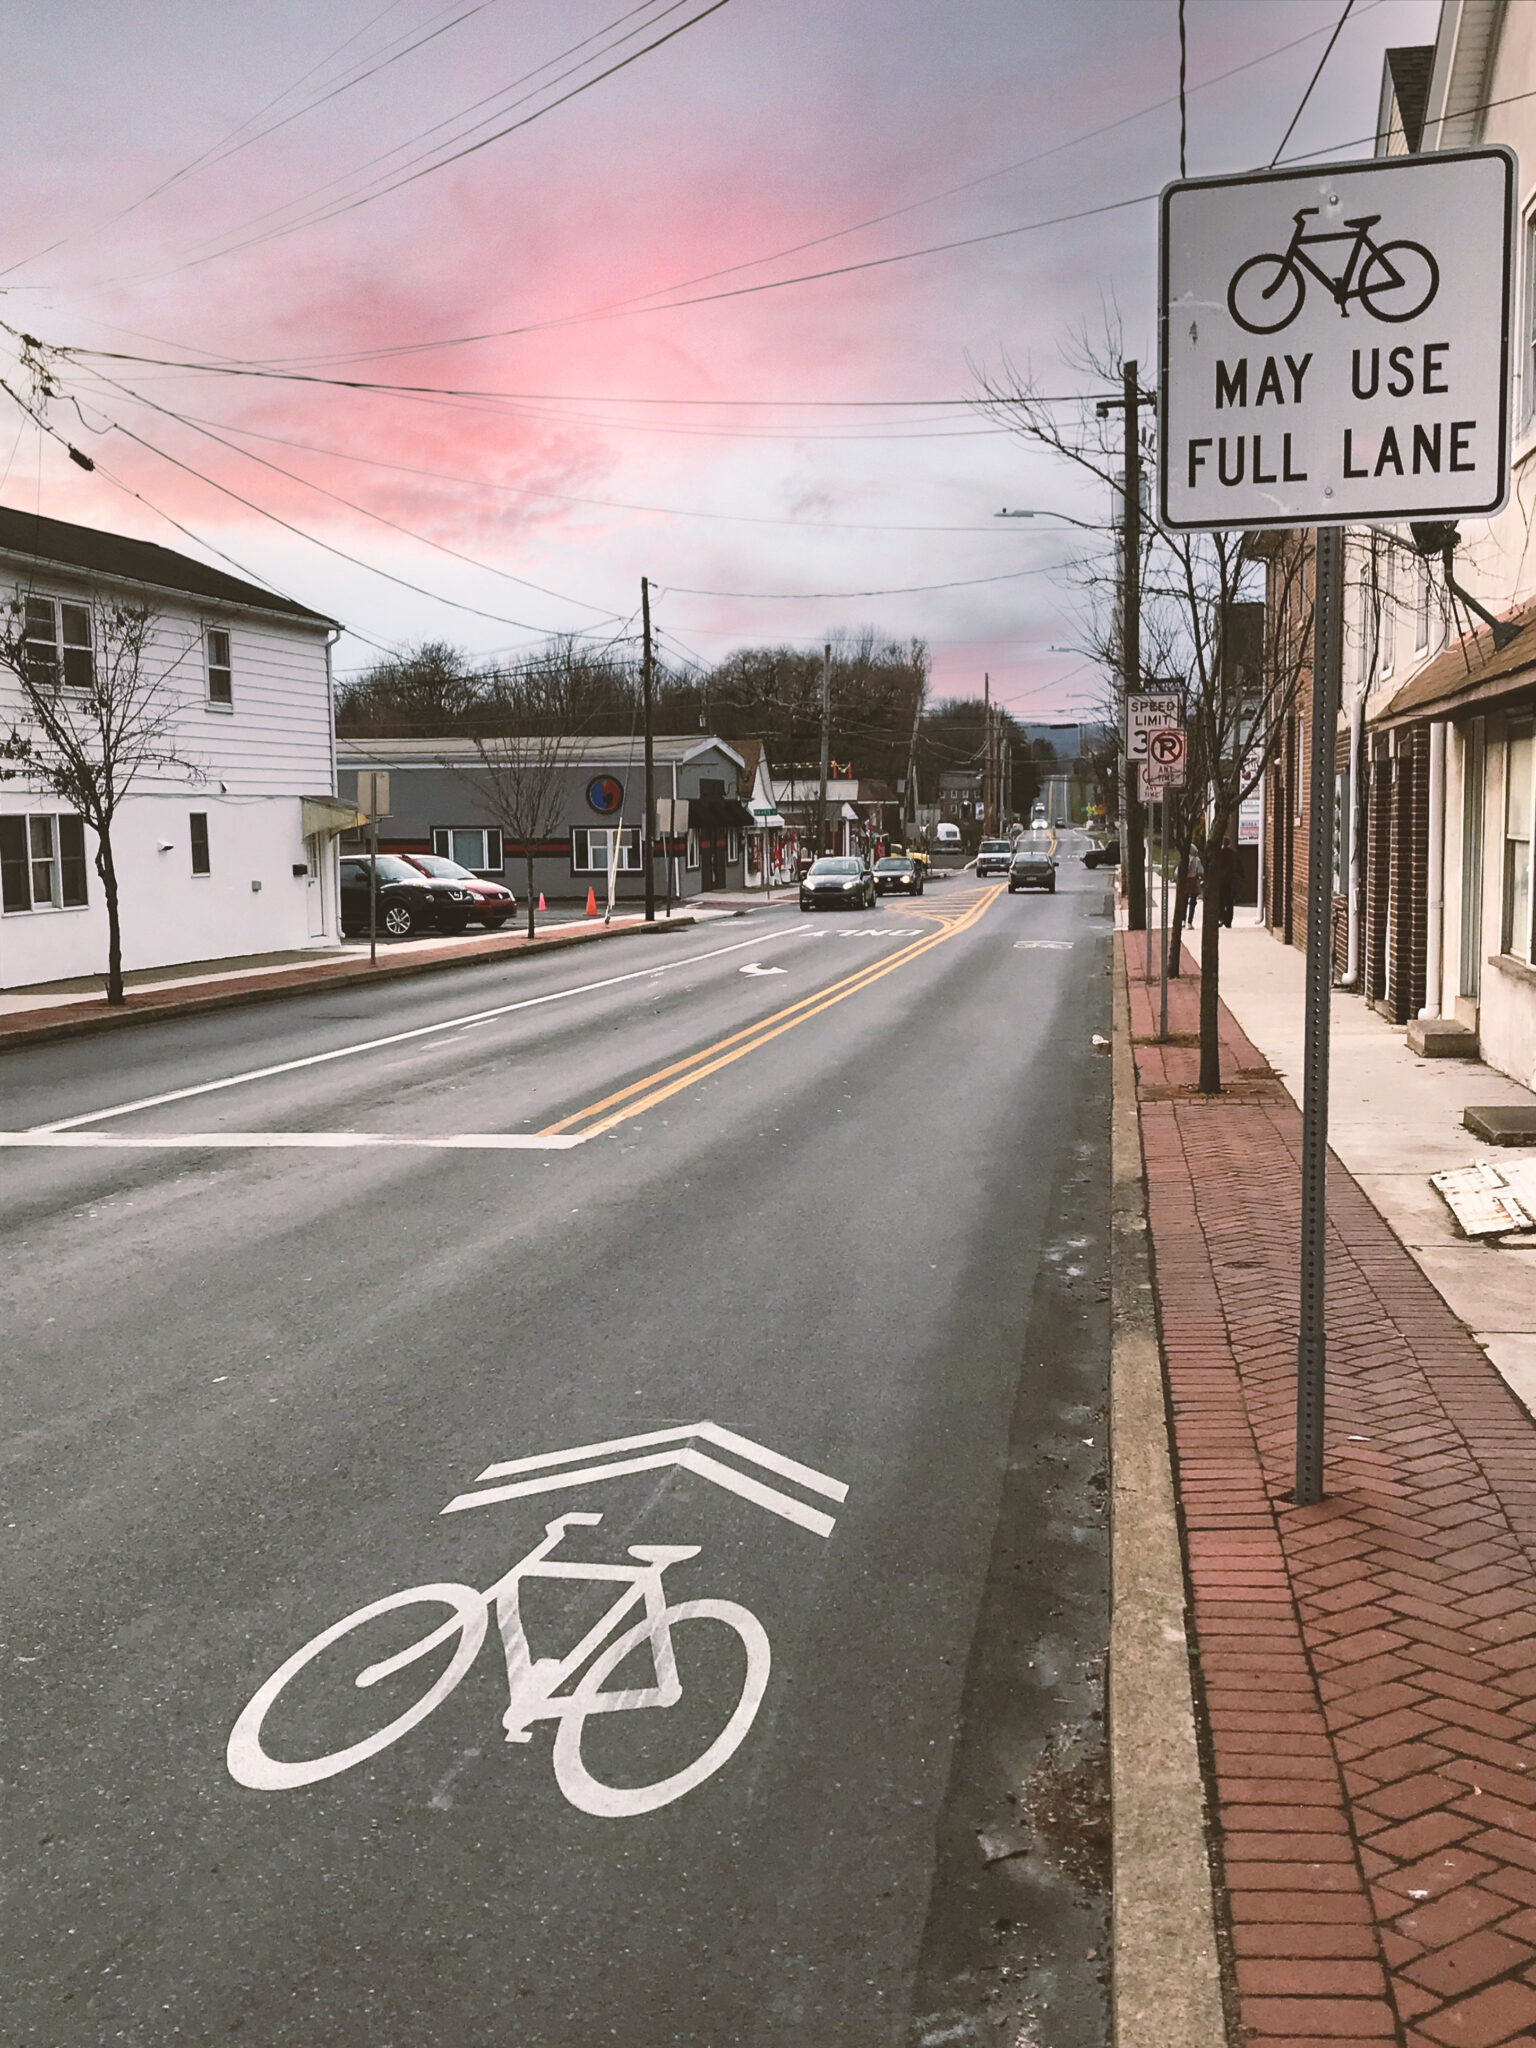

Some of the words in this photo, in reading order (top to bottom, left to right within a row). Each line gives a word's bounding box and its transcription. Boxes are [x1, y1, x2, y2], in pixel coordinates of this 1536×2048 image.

[1215, 353, 1313, 409] MAY
[1351, 342, 1450, 400] USE
[1188, 432, 1308, 488] FULL
[1343, 420, 1477, 479] LANE
[1131, 701, 1175, 712] SPEED
[1135, 715, 1169, 726] LIMIT
[1133, 730, 1148, 754] 3
[1158, 765, 1174, 773] ANY
[1158, 774, 1175, 782] TIME
